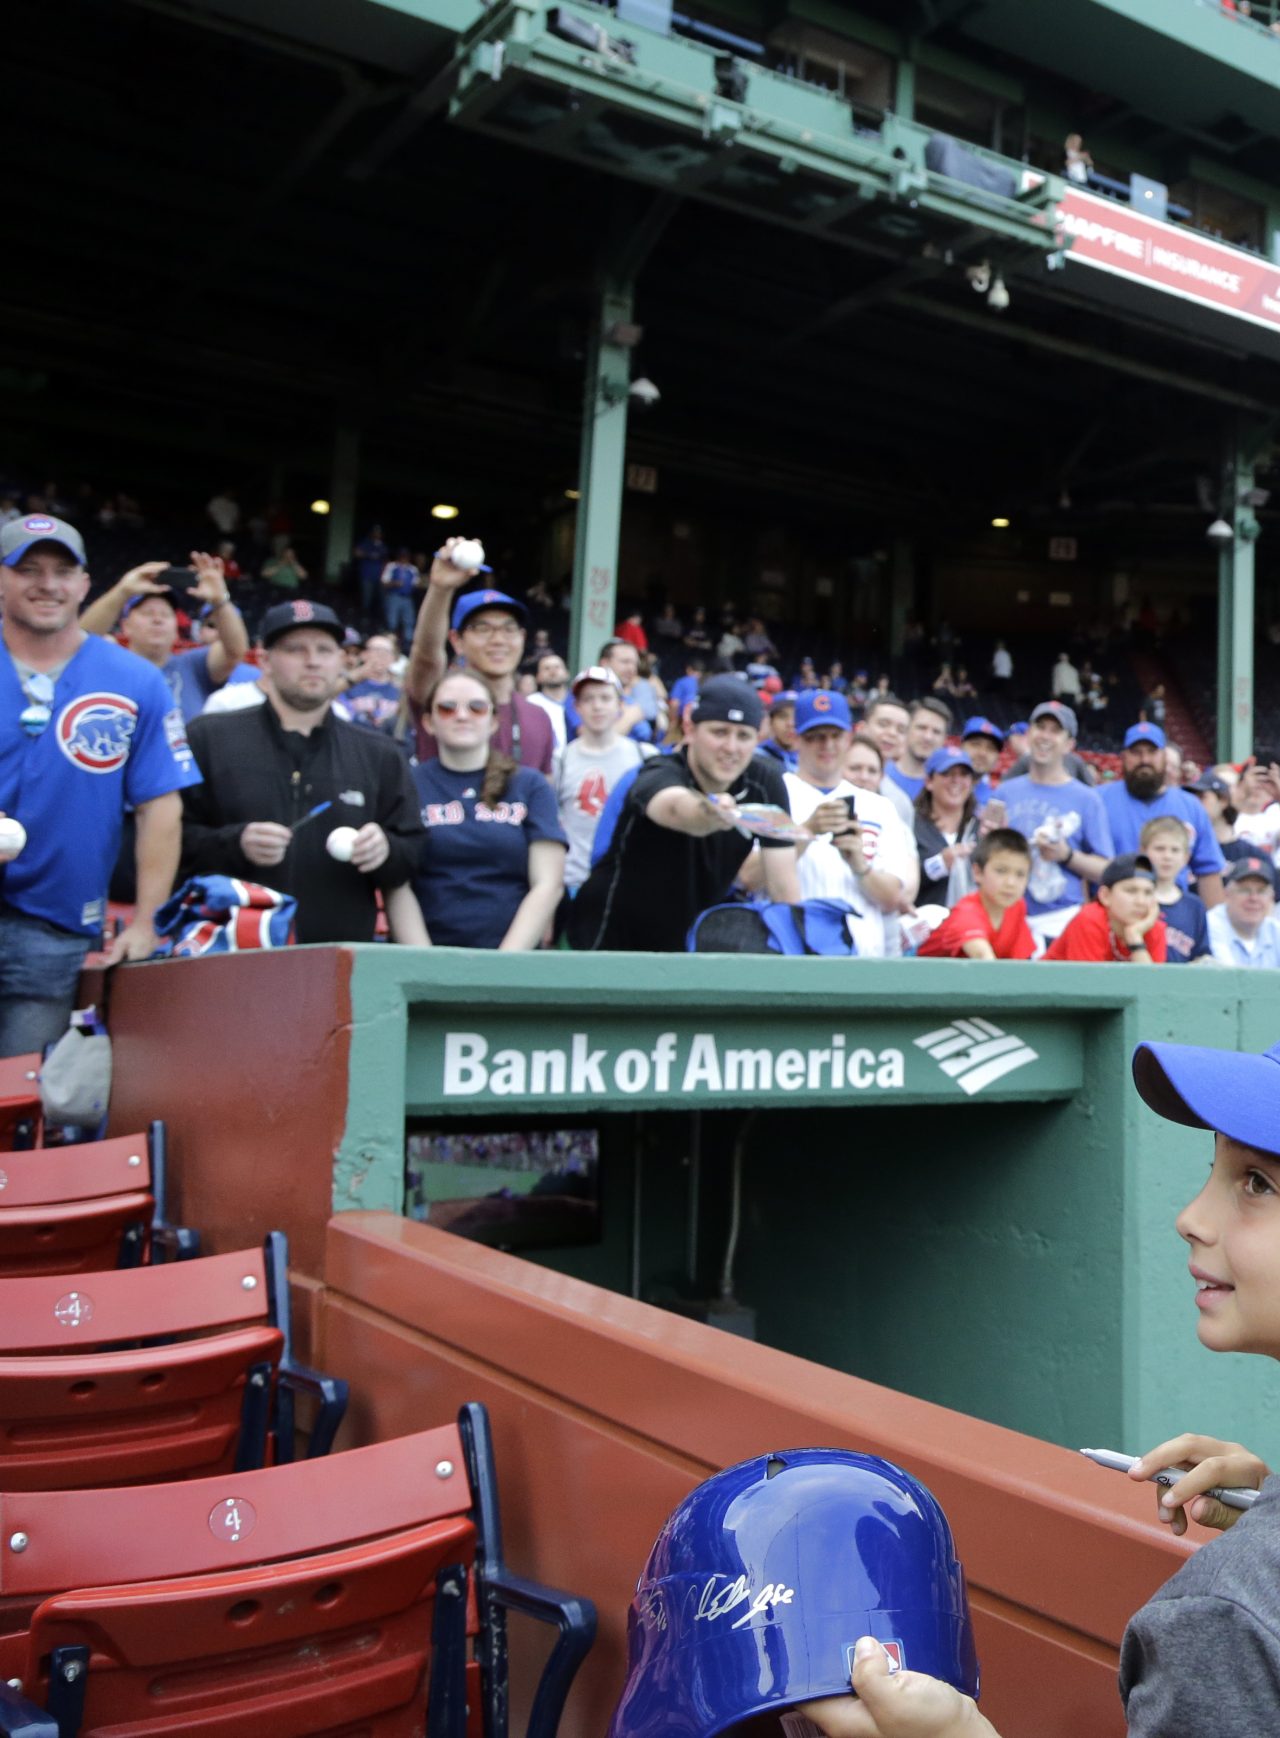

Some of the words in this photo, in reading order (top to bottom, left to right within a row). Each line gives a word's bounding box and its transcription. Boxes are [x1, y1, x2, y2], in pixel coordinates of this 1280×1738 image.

[1152, 246, 1241, 294] INSURANCE
[443, 1031, 608, 1096] Bank
[613, 1031, 678, 1093] of
[681, 1032, 906, 1093] America
[67, 1299, 82, 1319] 4
[224, 1507, 242, 1531] 4
